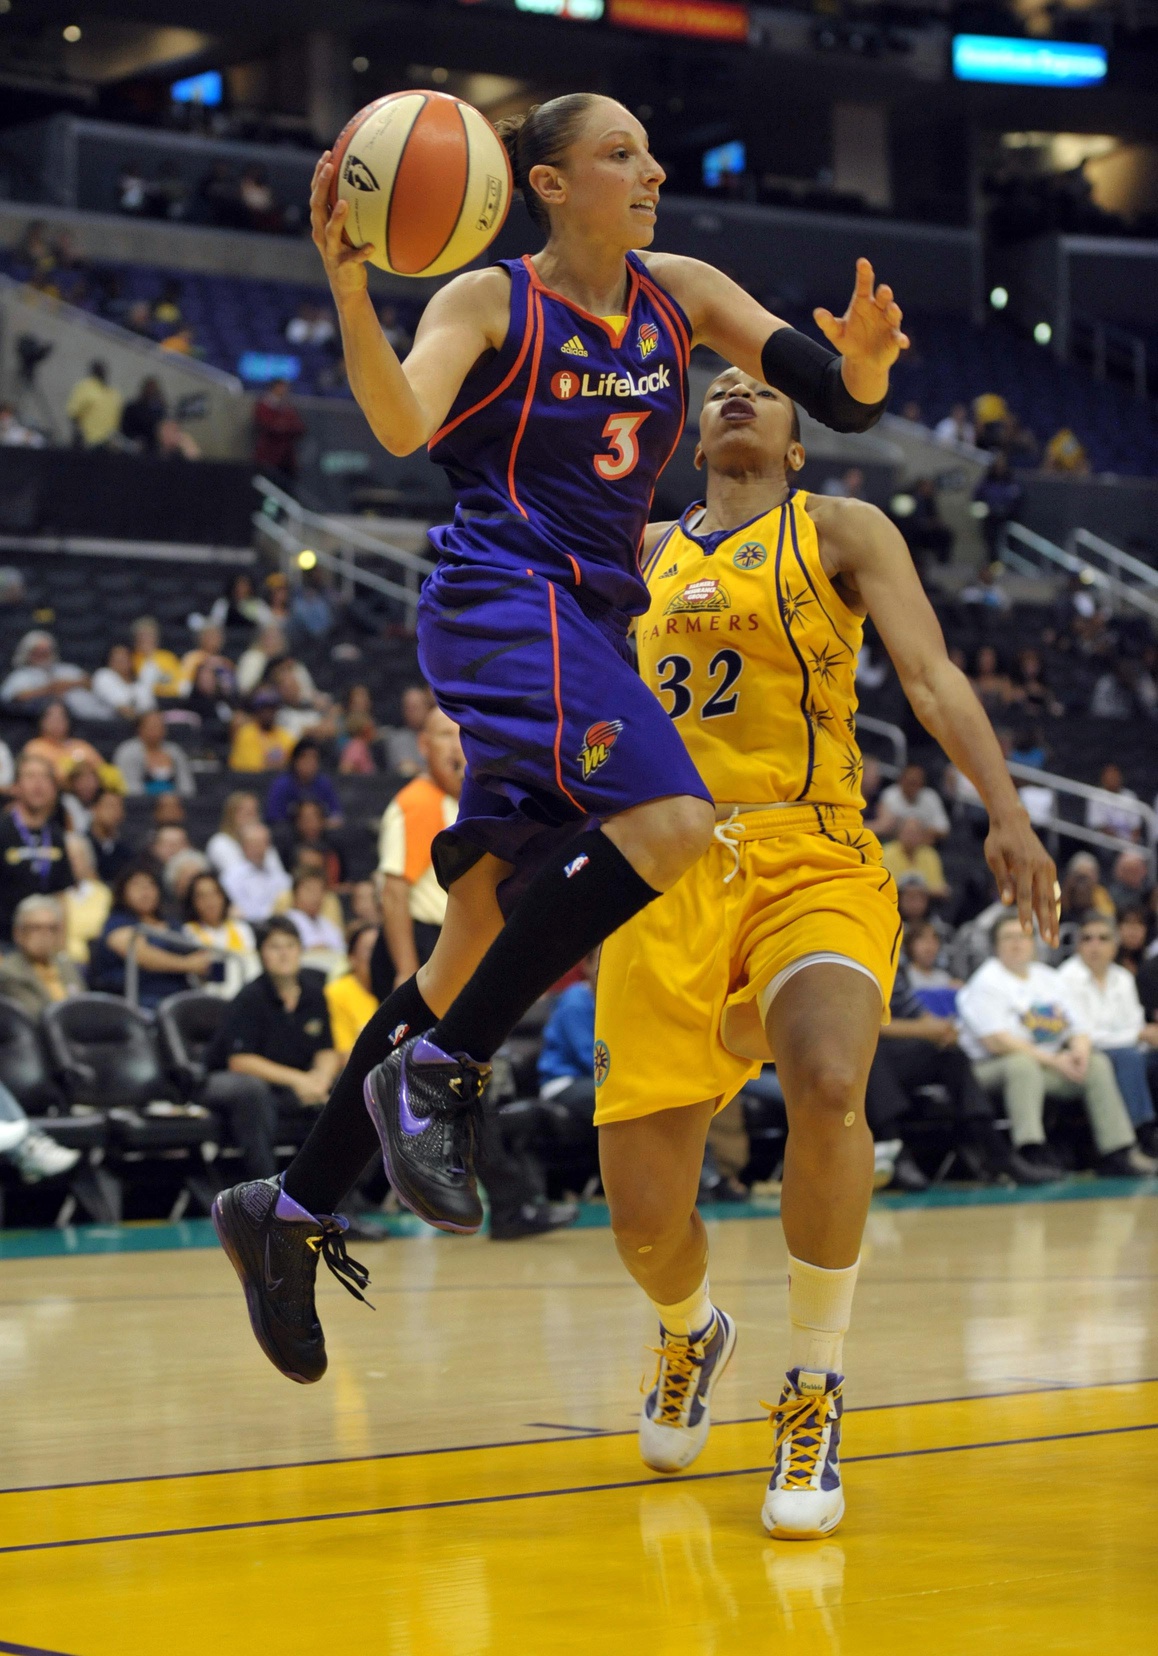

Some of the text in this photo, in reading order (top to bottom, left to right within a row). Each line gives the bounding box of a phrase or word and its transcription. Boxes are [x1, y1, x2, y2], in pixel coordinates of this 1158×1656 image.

[560, 346, 589, 358] adidas
[581, 363, 671, 397] LifeLock
[593, 410, 653, 481] 3
[642, 613, 759, 648] FARMERS
[656, 648, 743, 721] 32
